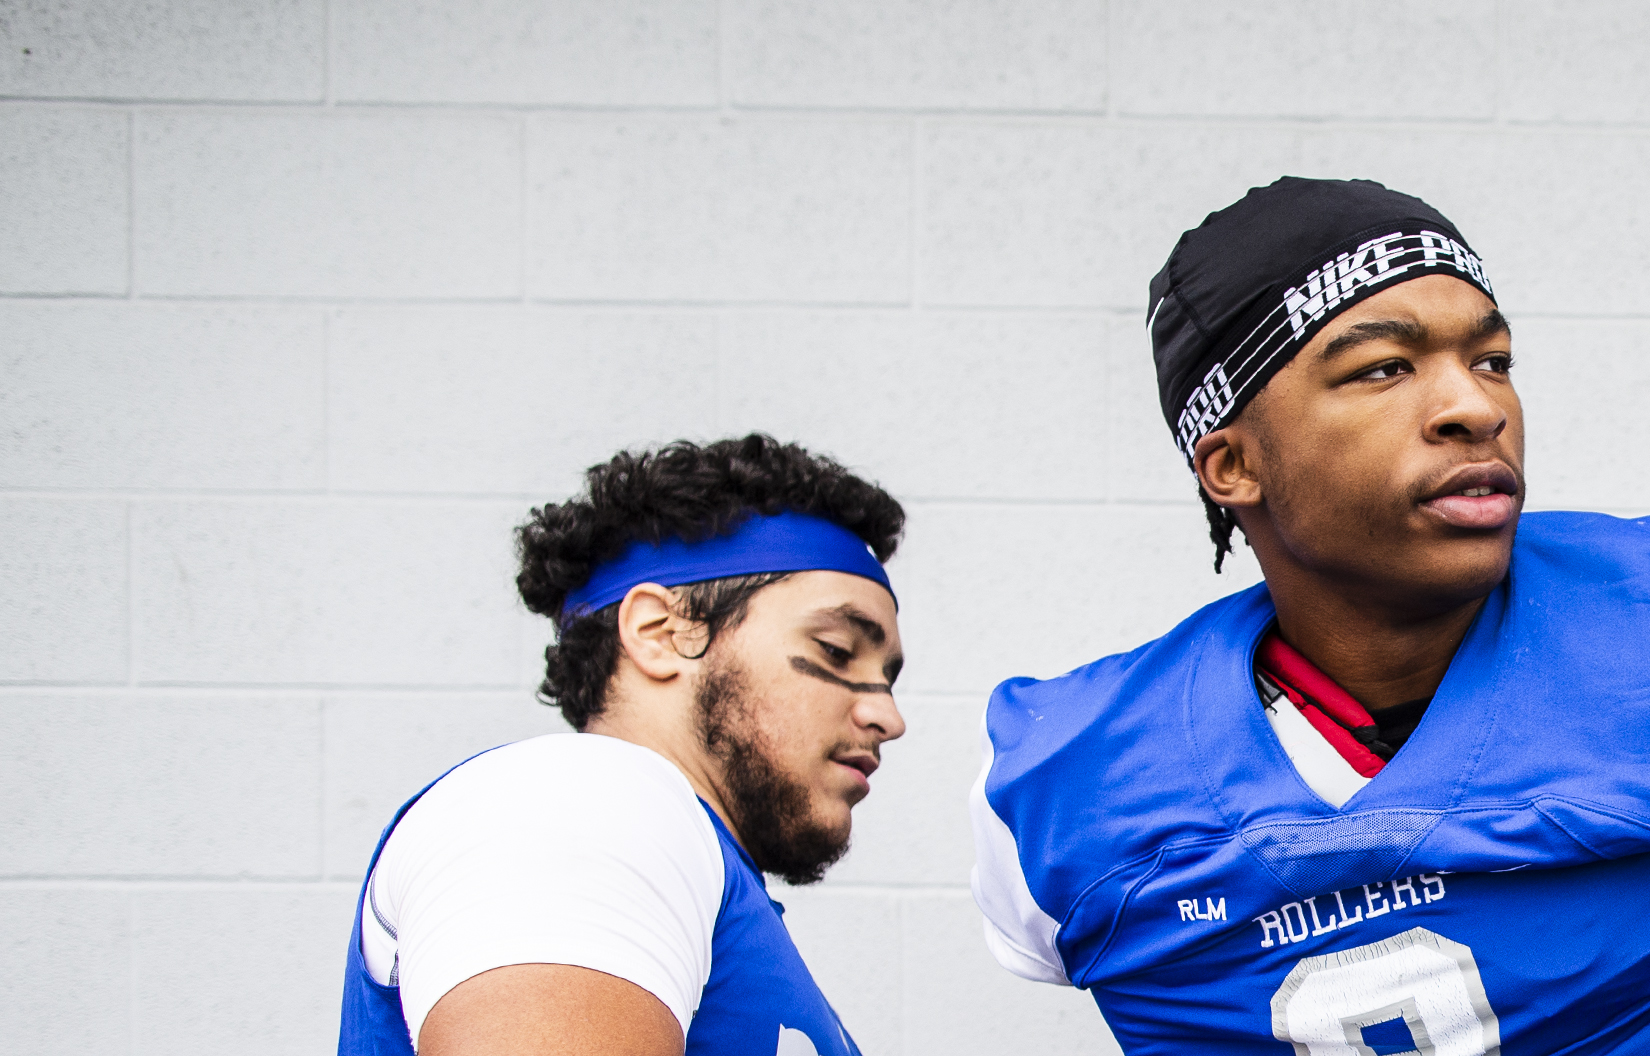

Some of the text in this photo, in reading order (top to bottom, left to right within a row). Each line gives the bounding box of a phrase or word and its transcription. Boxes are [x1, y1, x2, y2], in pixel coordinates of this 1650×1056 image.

[1283, 229, 1493, 341] NIKE PRO
[1177, 897, 1227, 922] RLM
[1252, 873, 1446, 948] ROLLERS
